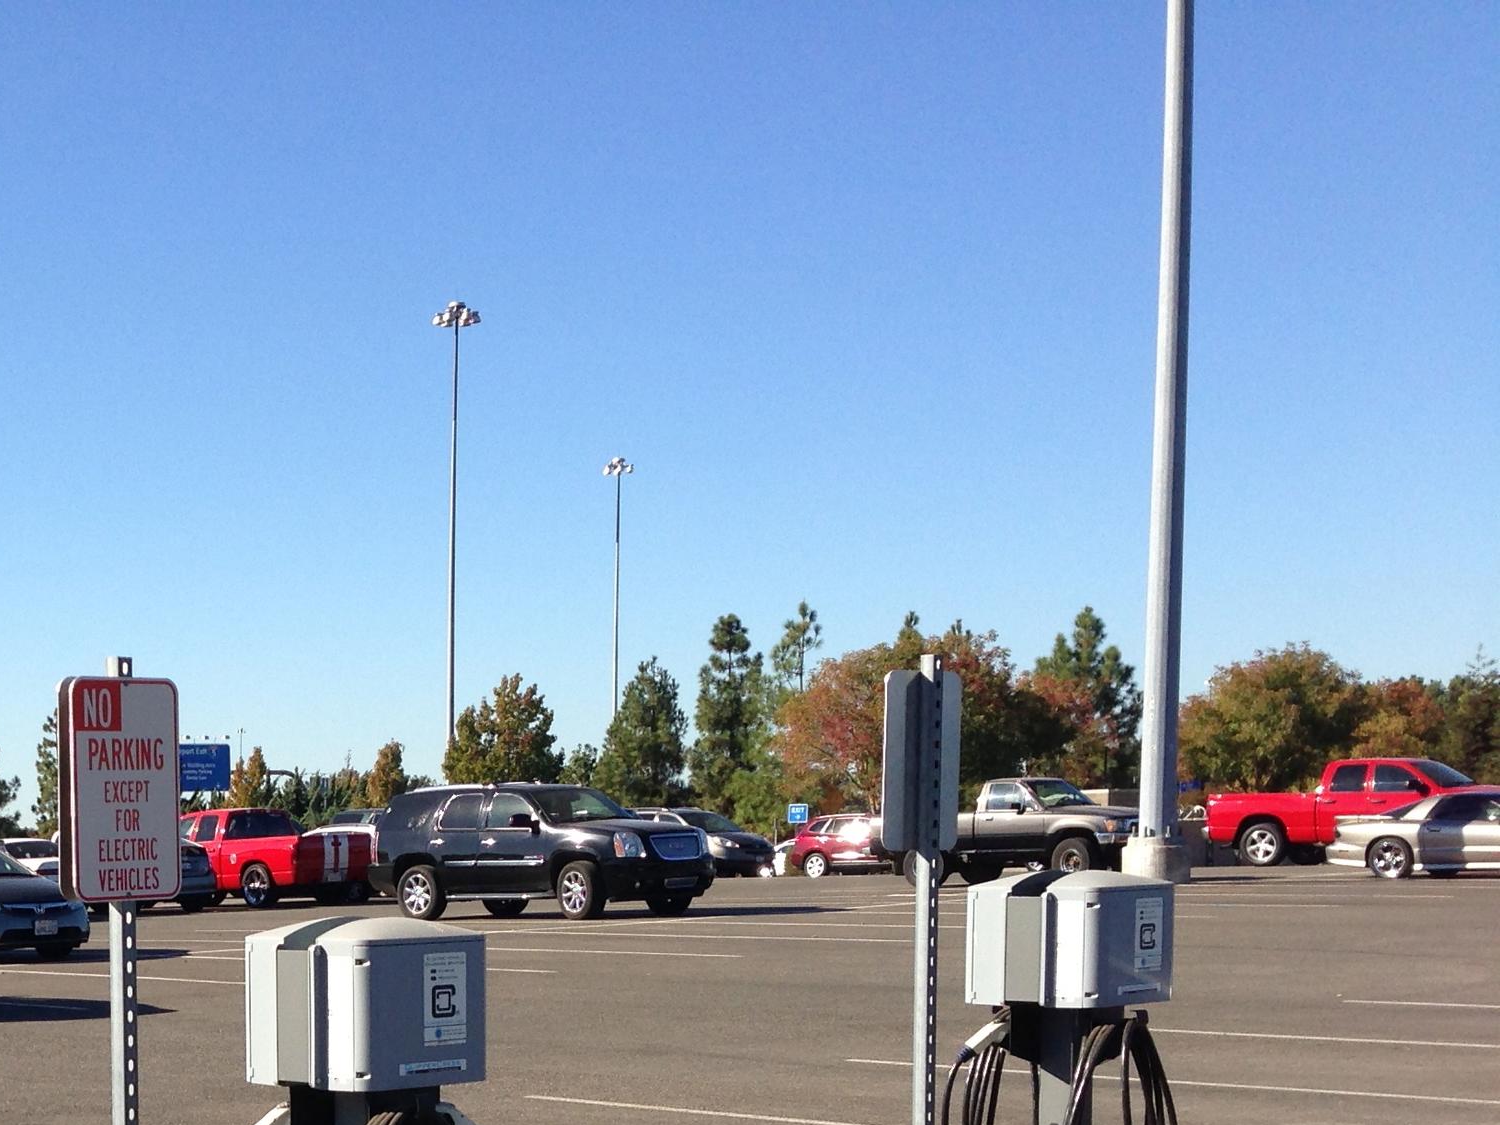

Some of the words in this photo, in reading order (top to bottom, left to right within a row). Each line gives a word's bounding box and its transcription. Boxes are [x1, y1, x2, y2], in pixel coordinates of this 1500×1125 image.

[83, 688, 112, 728] NO
[88, 738, 164, 771] PARKING
[104, 780, 150, 803] EXCEPT
[115, 809, 140, 832] FOR
[98, 838, 158, 862] ELECTRIC
[99, 867, 160, 892] VEHICLES
